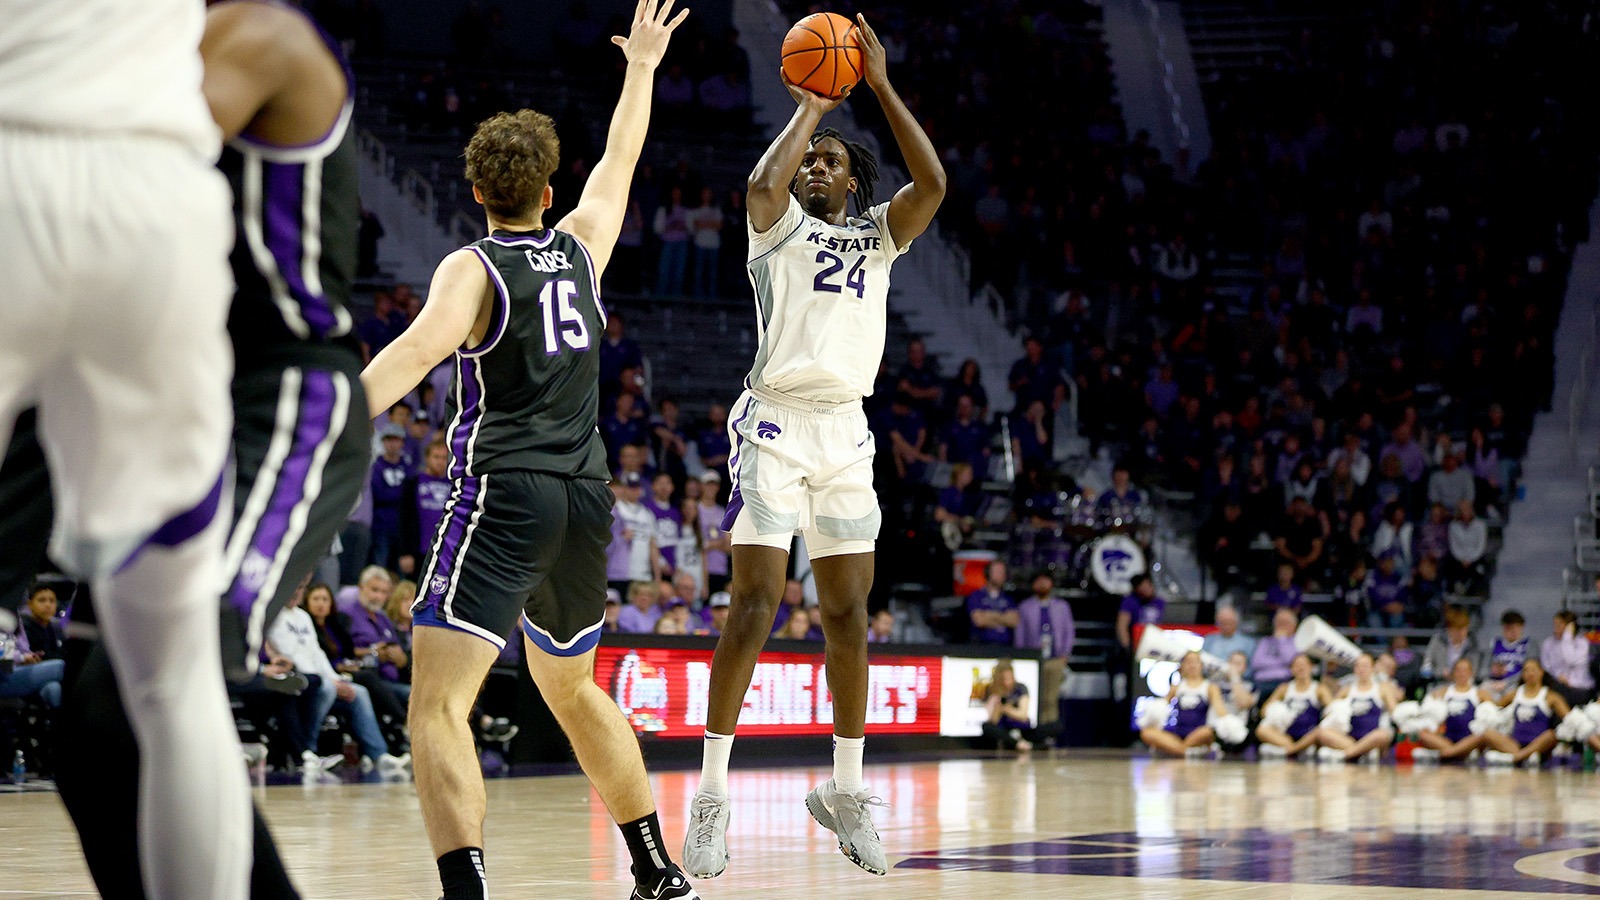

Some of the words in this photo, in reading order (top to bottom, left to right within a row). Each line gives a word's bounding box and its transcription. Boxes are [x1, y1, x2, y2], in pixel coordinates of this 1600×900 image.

[806, 231, 881, 253] K-STATE
[813, 250, 867, 299] 24
[538, 279, 591, 356] 15
[685, 661, 814, 726] RSING
